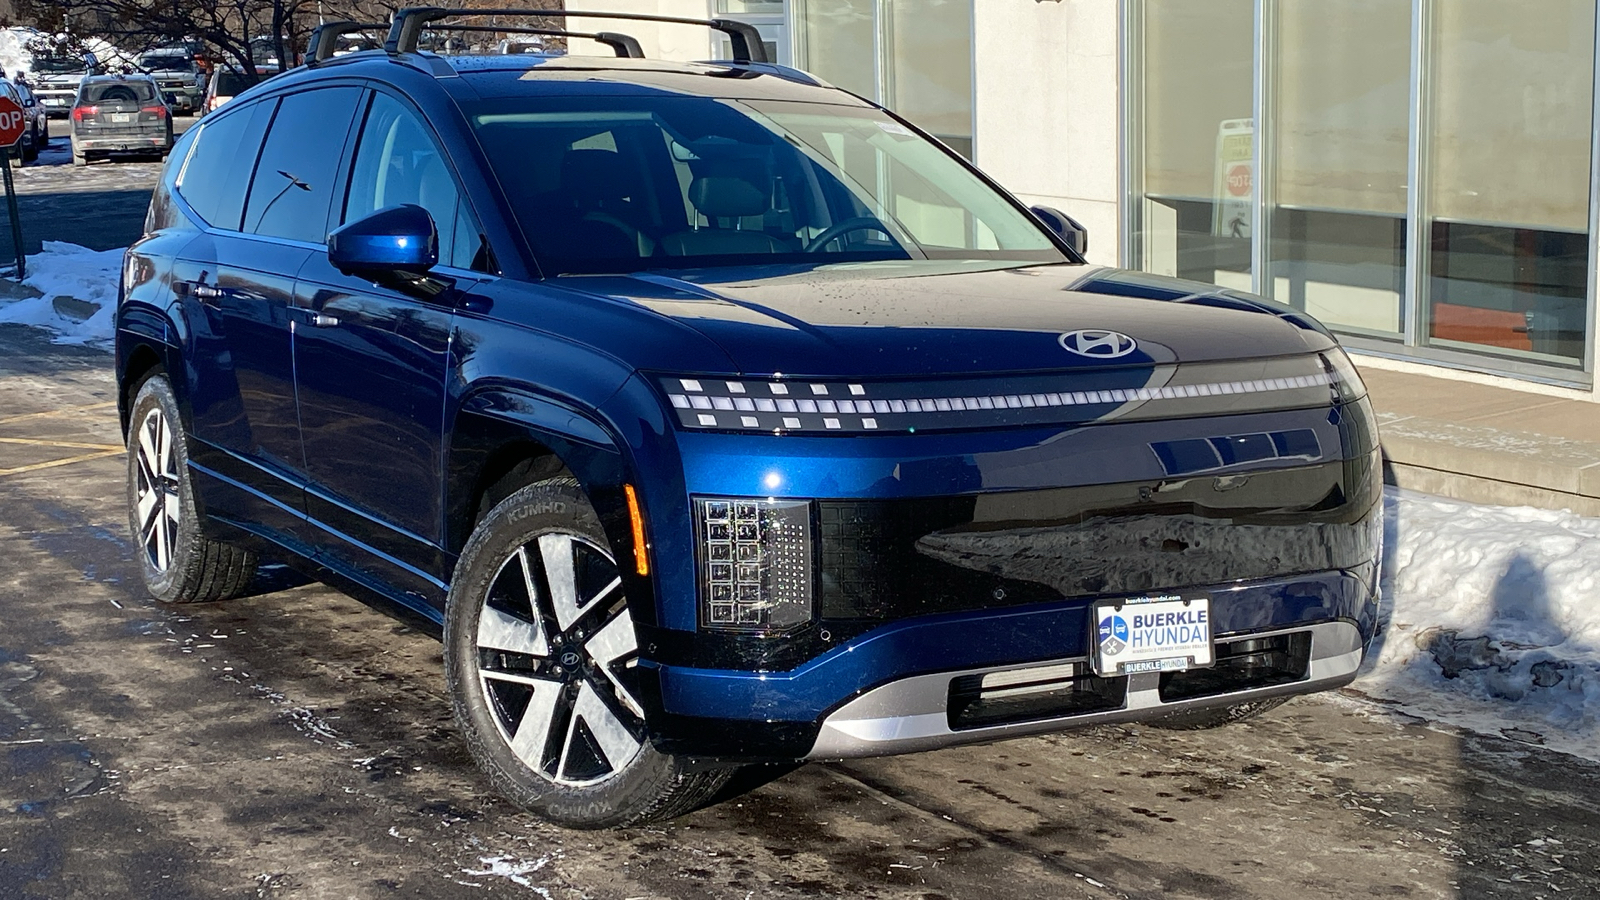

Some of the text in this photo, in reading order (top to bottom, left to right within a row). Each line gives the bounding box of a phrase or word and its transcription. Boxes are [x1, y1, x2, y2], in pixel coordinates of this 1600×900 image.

[507, 502, 566, 525] KUMHO
[1133, 610, 1207, 628] BUERKLE
[1133, 625, 1207, 647] HYUNDAI
[1126, 658, 1187, 672] BUERKLE HYUNDAI
